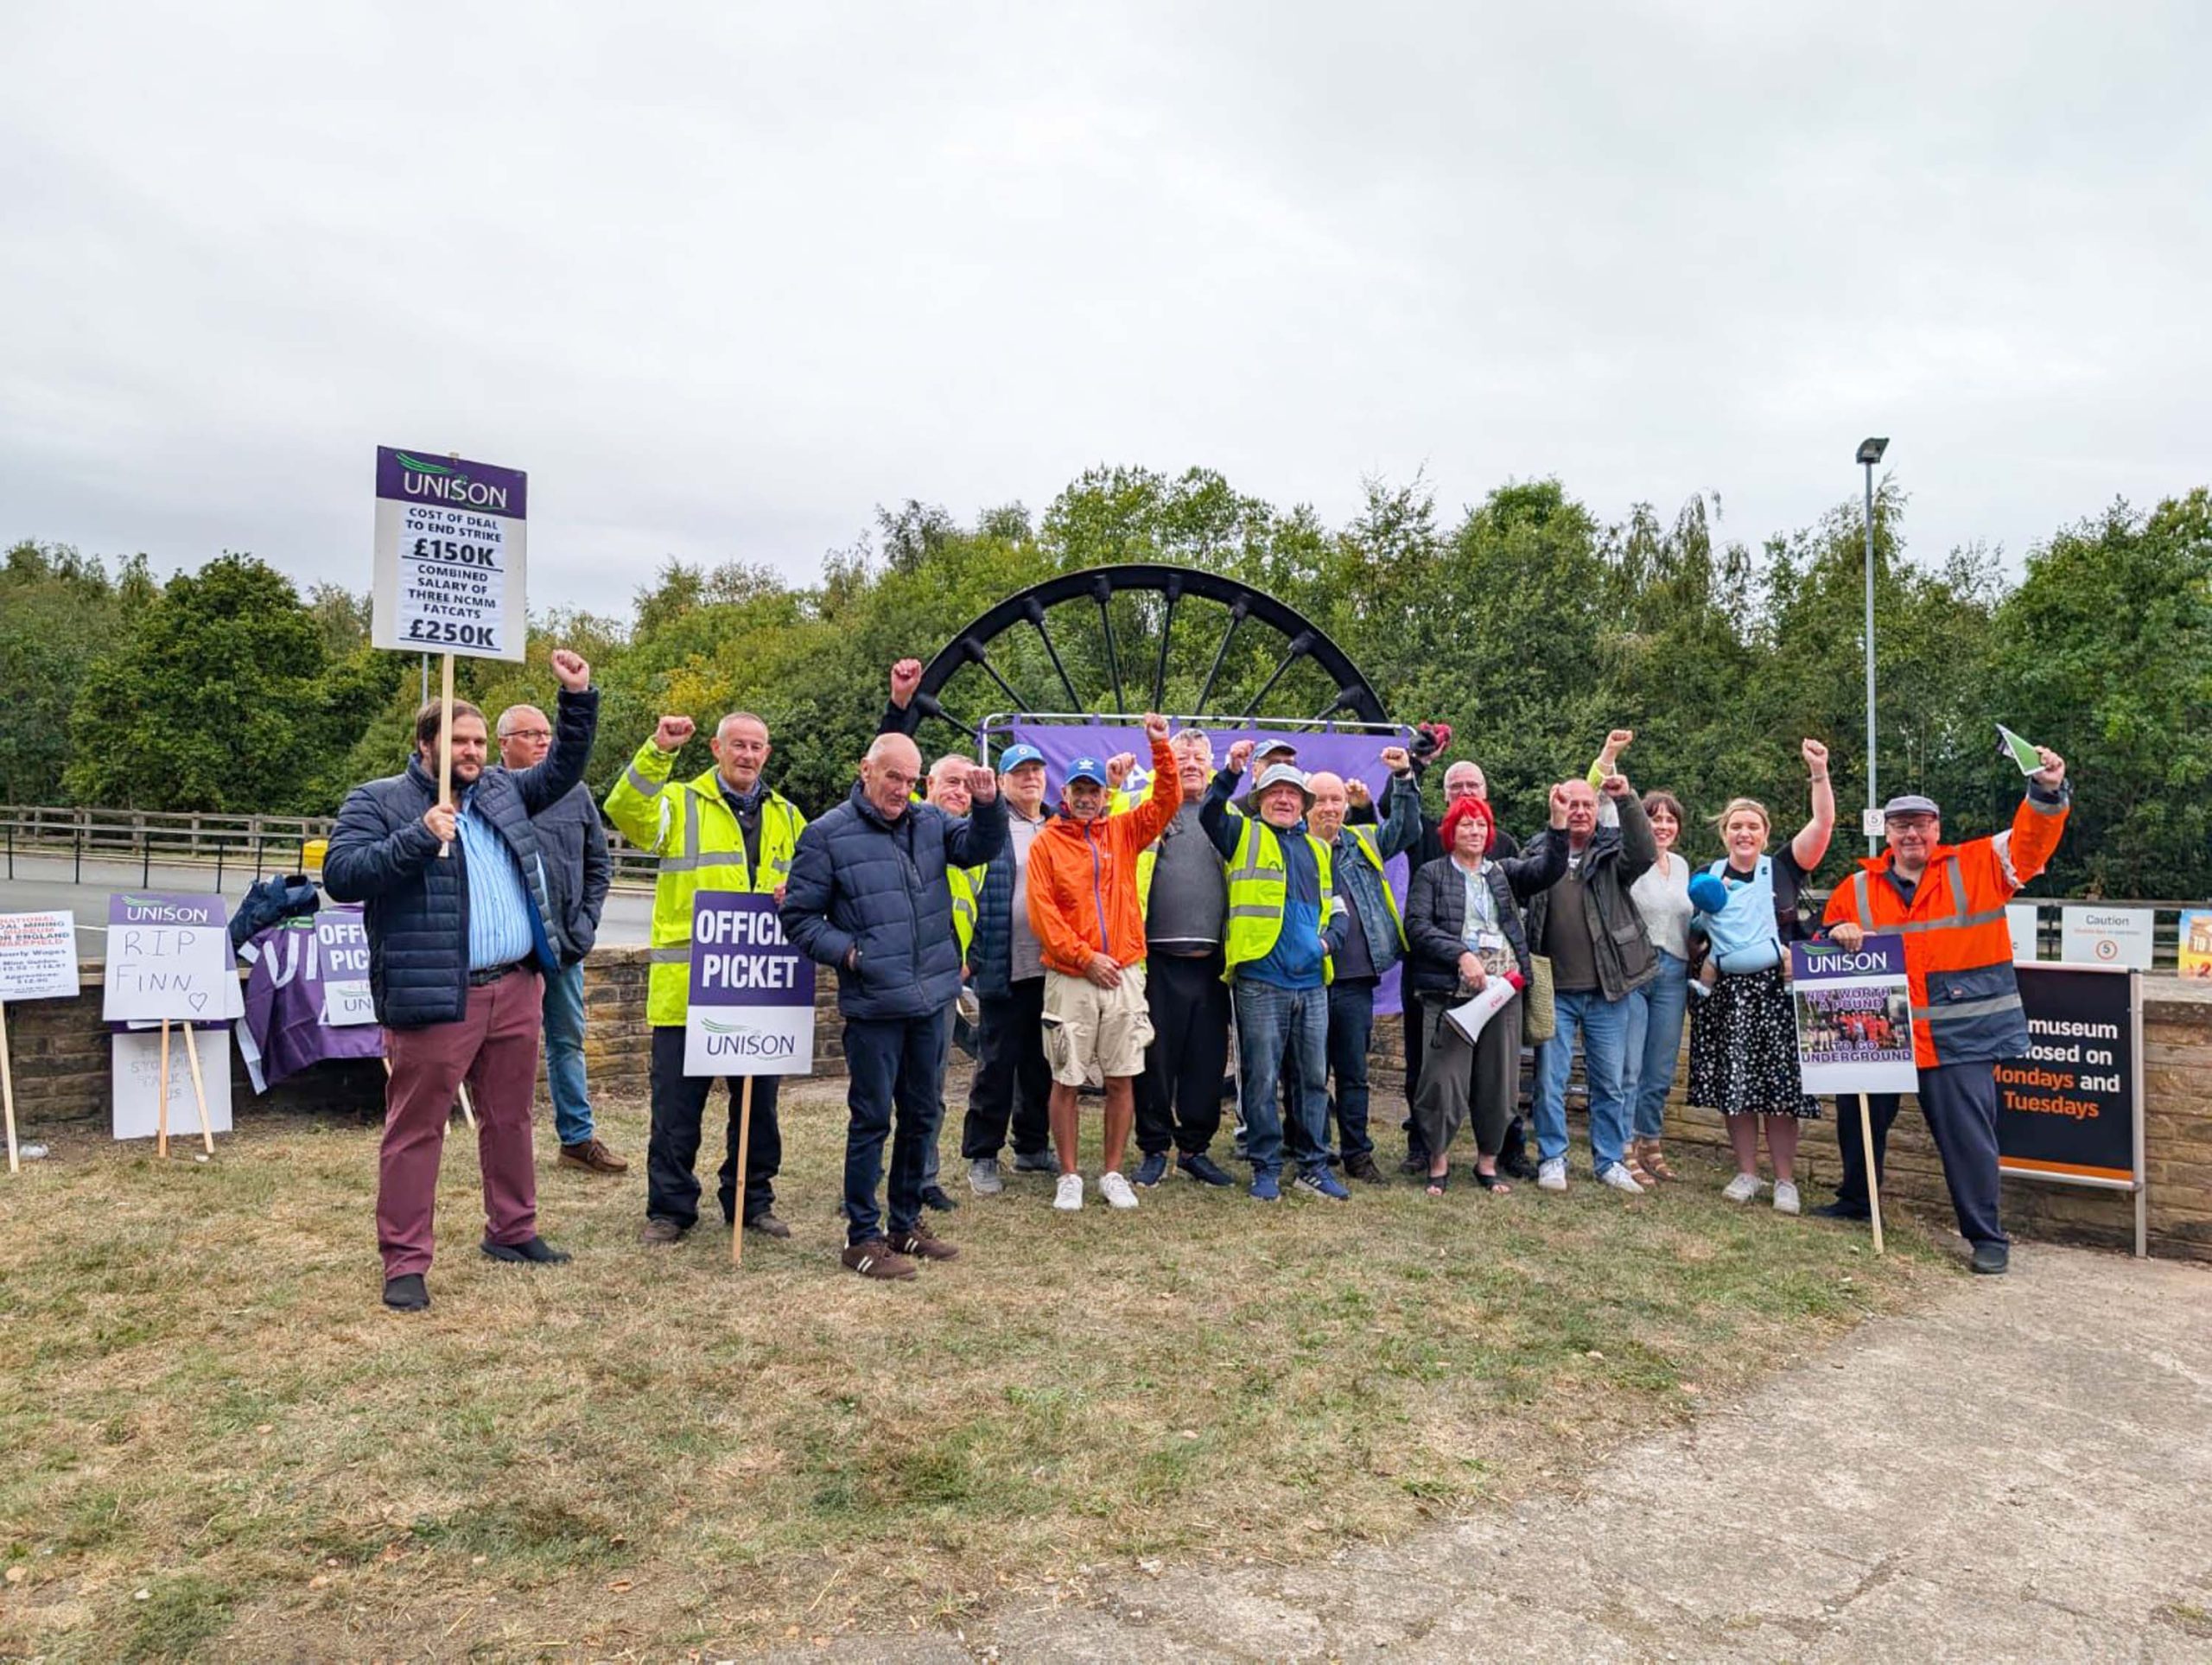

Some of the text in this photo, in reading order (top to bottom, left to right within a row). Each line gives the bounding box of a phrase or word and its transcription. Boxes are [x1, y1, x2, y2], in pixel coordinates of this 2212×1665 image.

[404, 472, 506, 508] UNISON
[409, 507, 498, 530] COST OF DEAL
[405, 519, 501, 543] TO END STRIKE
[414, 537, 495, 567] £150K
[418, 564, 488, 581] COMBINED
[417, 577, 487, 594] SALARY OF
[408, 588, 496, 608] THREE NCMM
[423, 603, 480, 619] FATCATS
[410, 619, 495, 646] £250K
[127, 906, 208, 922] UNISON
[2086, 914, 2130, 926] Caution
[696, 910, 789, 945] OFFICI
[125, 931, 195, 956] RIP
[2102, 944, 2111, 954] 5
[702, 954, 799, 988] PICKET
[1808, 951, 1887, 973] UNISON
[117, 964, 192, 993] FINN
[1840, 987, 1891, 999] WORTH
[1819, 998, 1884, 1011] A POUND
[2028, 1019, 2118, 1039] museum
[707, 1034, 795, 1055] UNISON
[1834, 1040, 1878, 1051] TO GO
[1802, 1051, 1911, 1063] UNDERGROUND
[2086, 1049, 2113, 1065] on
[2080, 1074, 2120, 1092] and
[2004, 1090, 2100, 1120] Tuesdays
